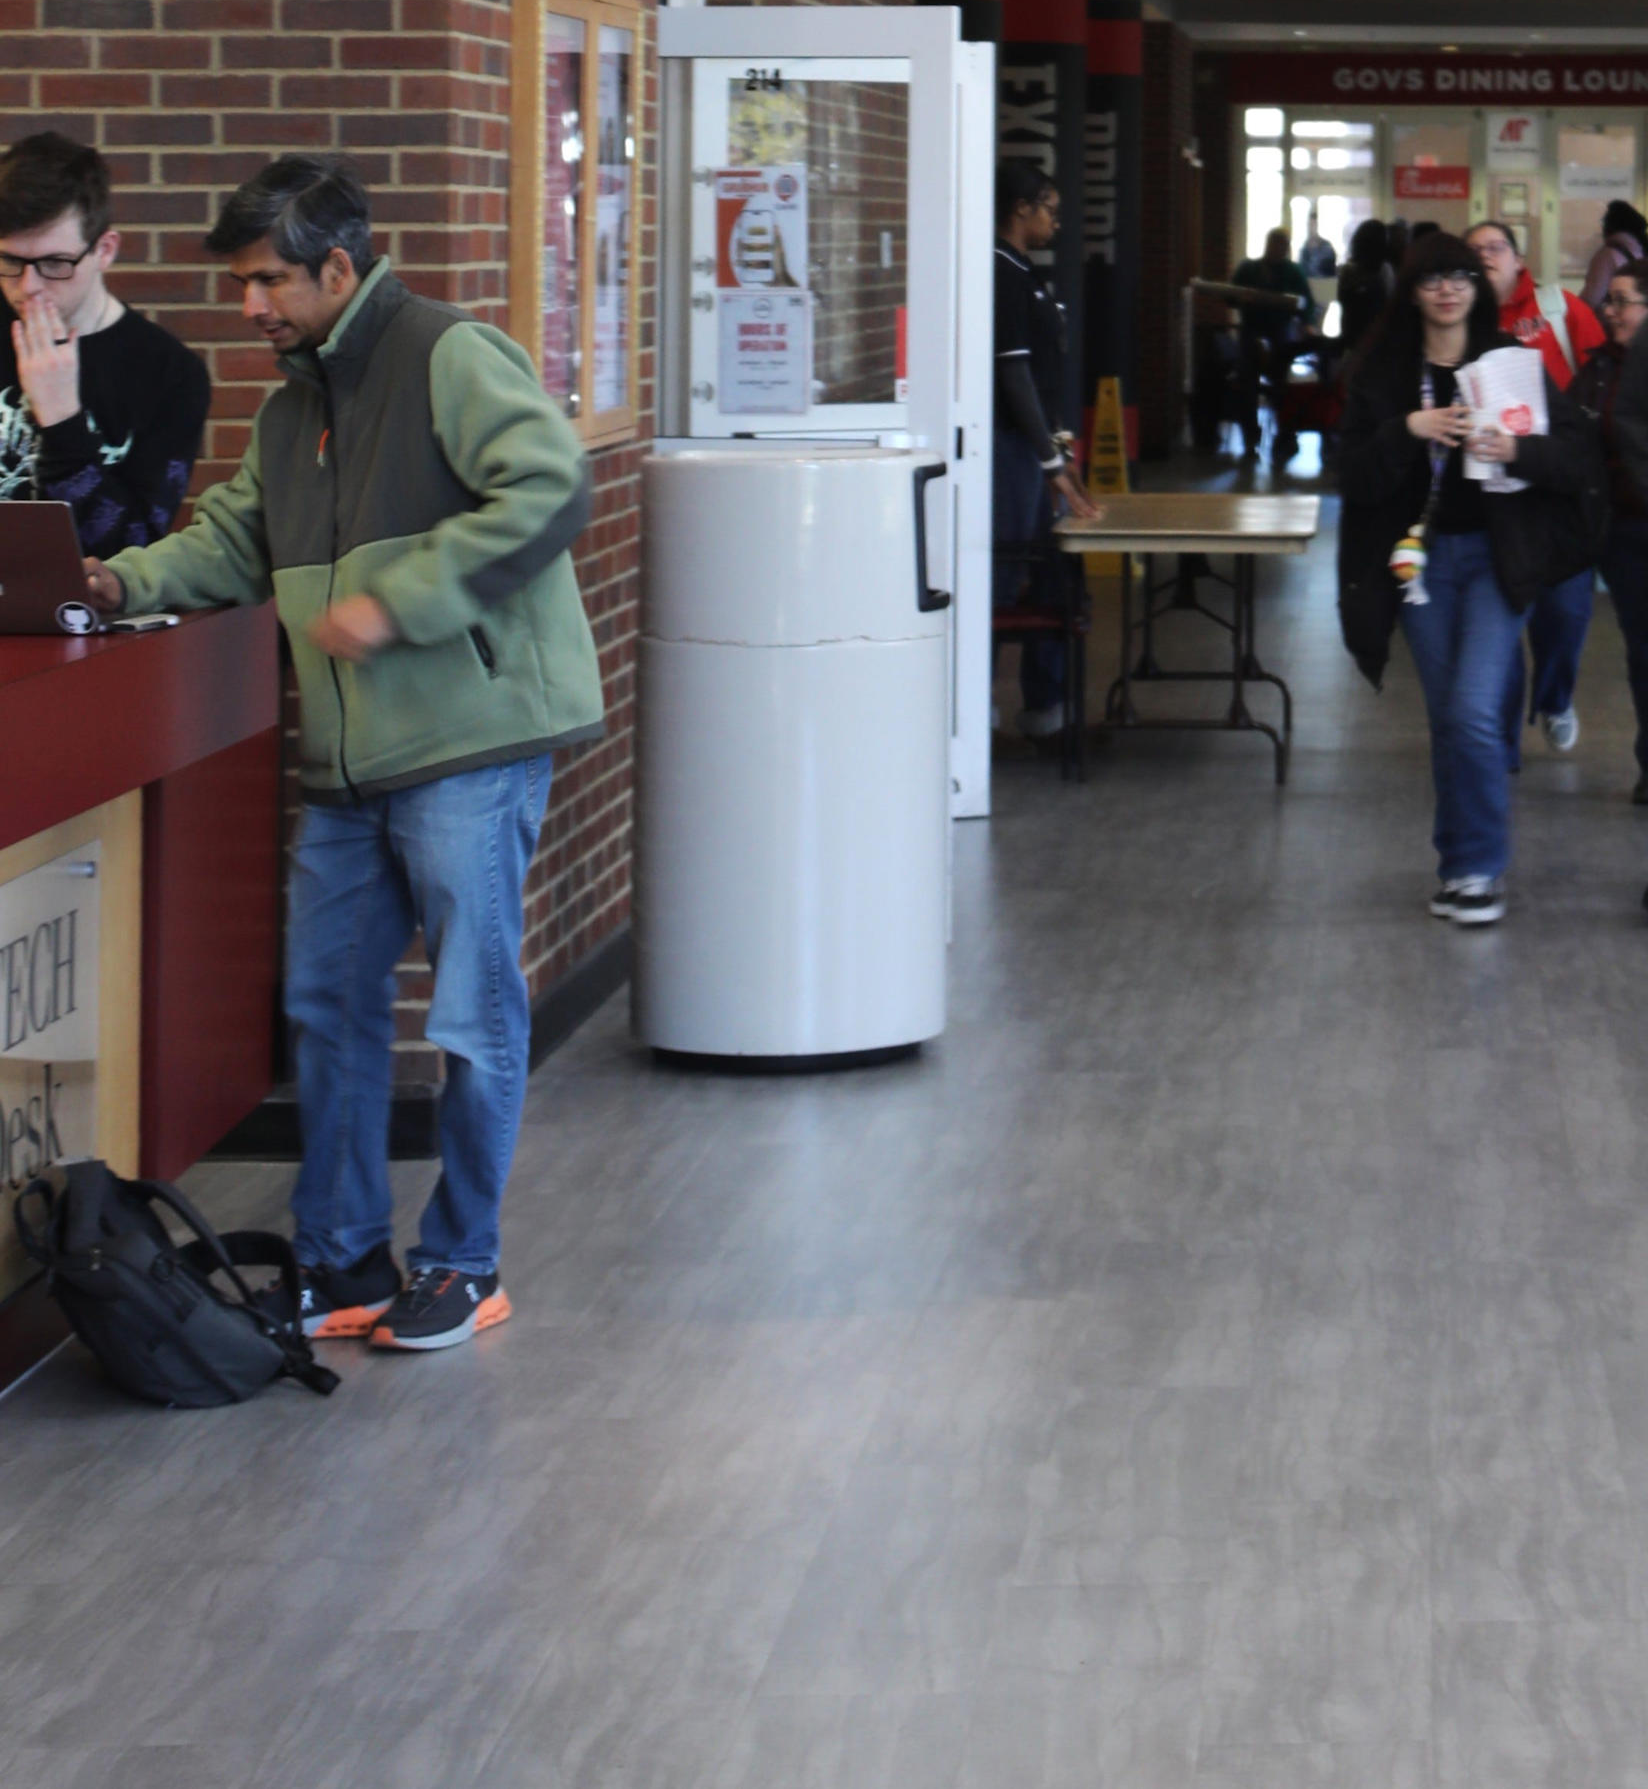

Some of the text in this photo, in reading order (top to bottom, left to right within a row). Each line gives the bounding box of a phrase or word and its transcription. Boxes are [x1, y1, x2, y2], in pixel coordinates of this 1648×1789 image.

[1332, 67, 1426, 91] GOVS
[1434, 68, 1554, 92] DINING
[0, 909, 78, 1052] ECH
[0, 1064, 64, 1197] esk
